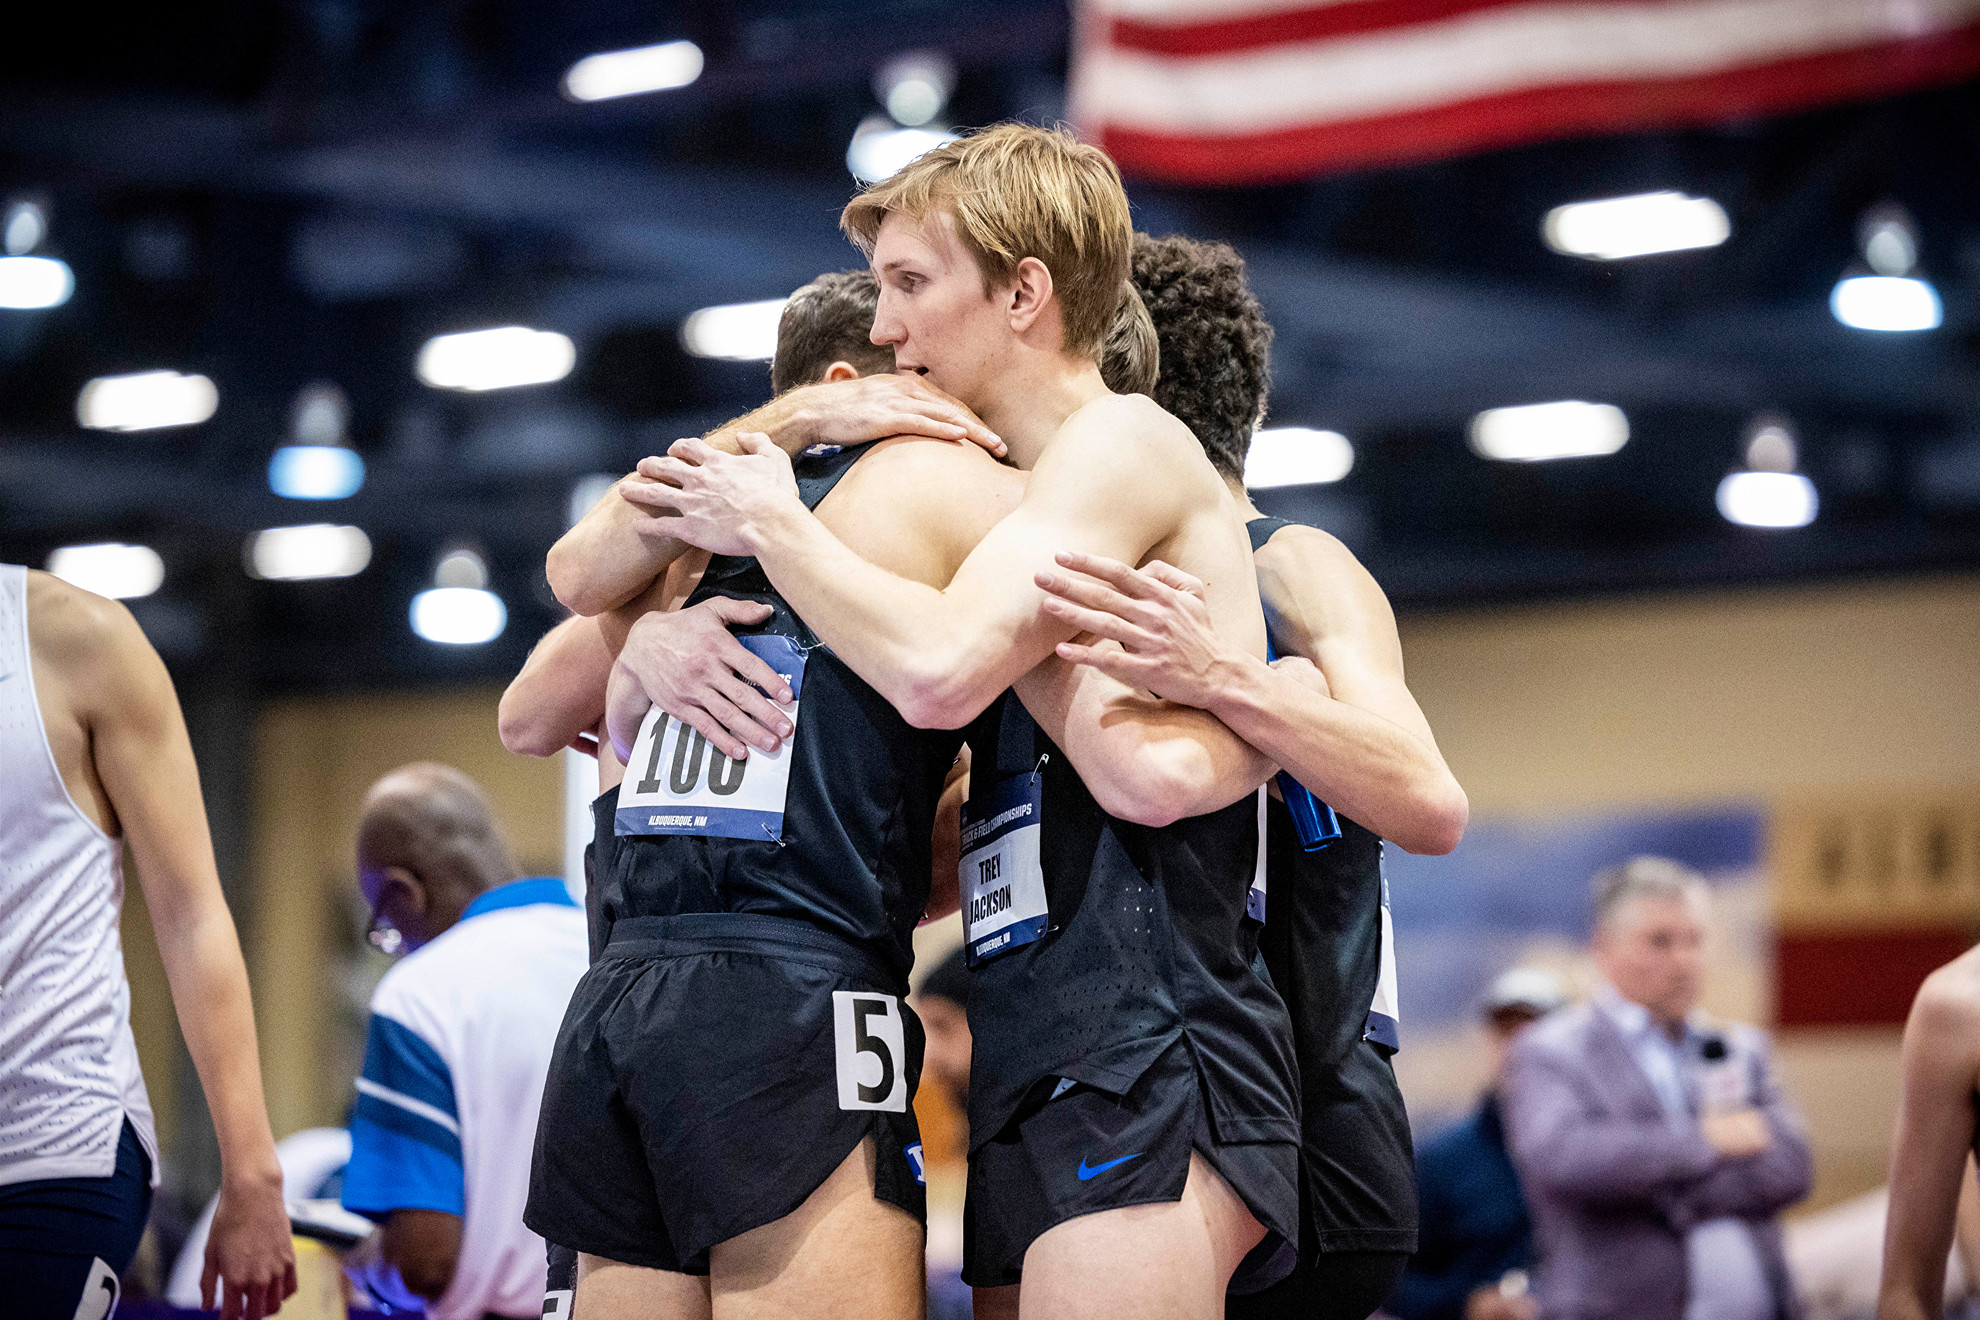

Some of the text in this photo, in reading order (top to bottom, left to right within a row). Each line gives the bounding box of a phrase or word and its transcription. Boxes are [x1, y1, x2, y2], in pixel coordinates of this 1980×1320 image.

[693, 815, 708, 827] NM
[991, 803, 1032, 831] CHAMPIONSHIPS
[979, 853, 1001, 885] TREY
[969, 884, 1012, 926] JACKSON
[853, 998, 895, 1104] 5
